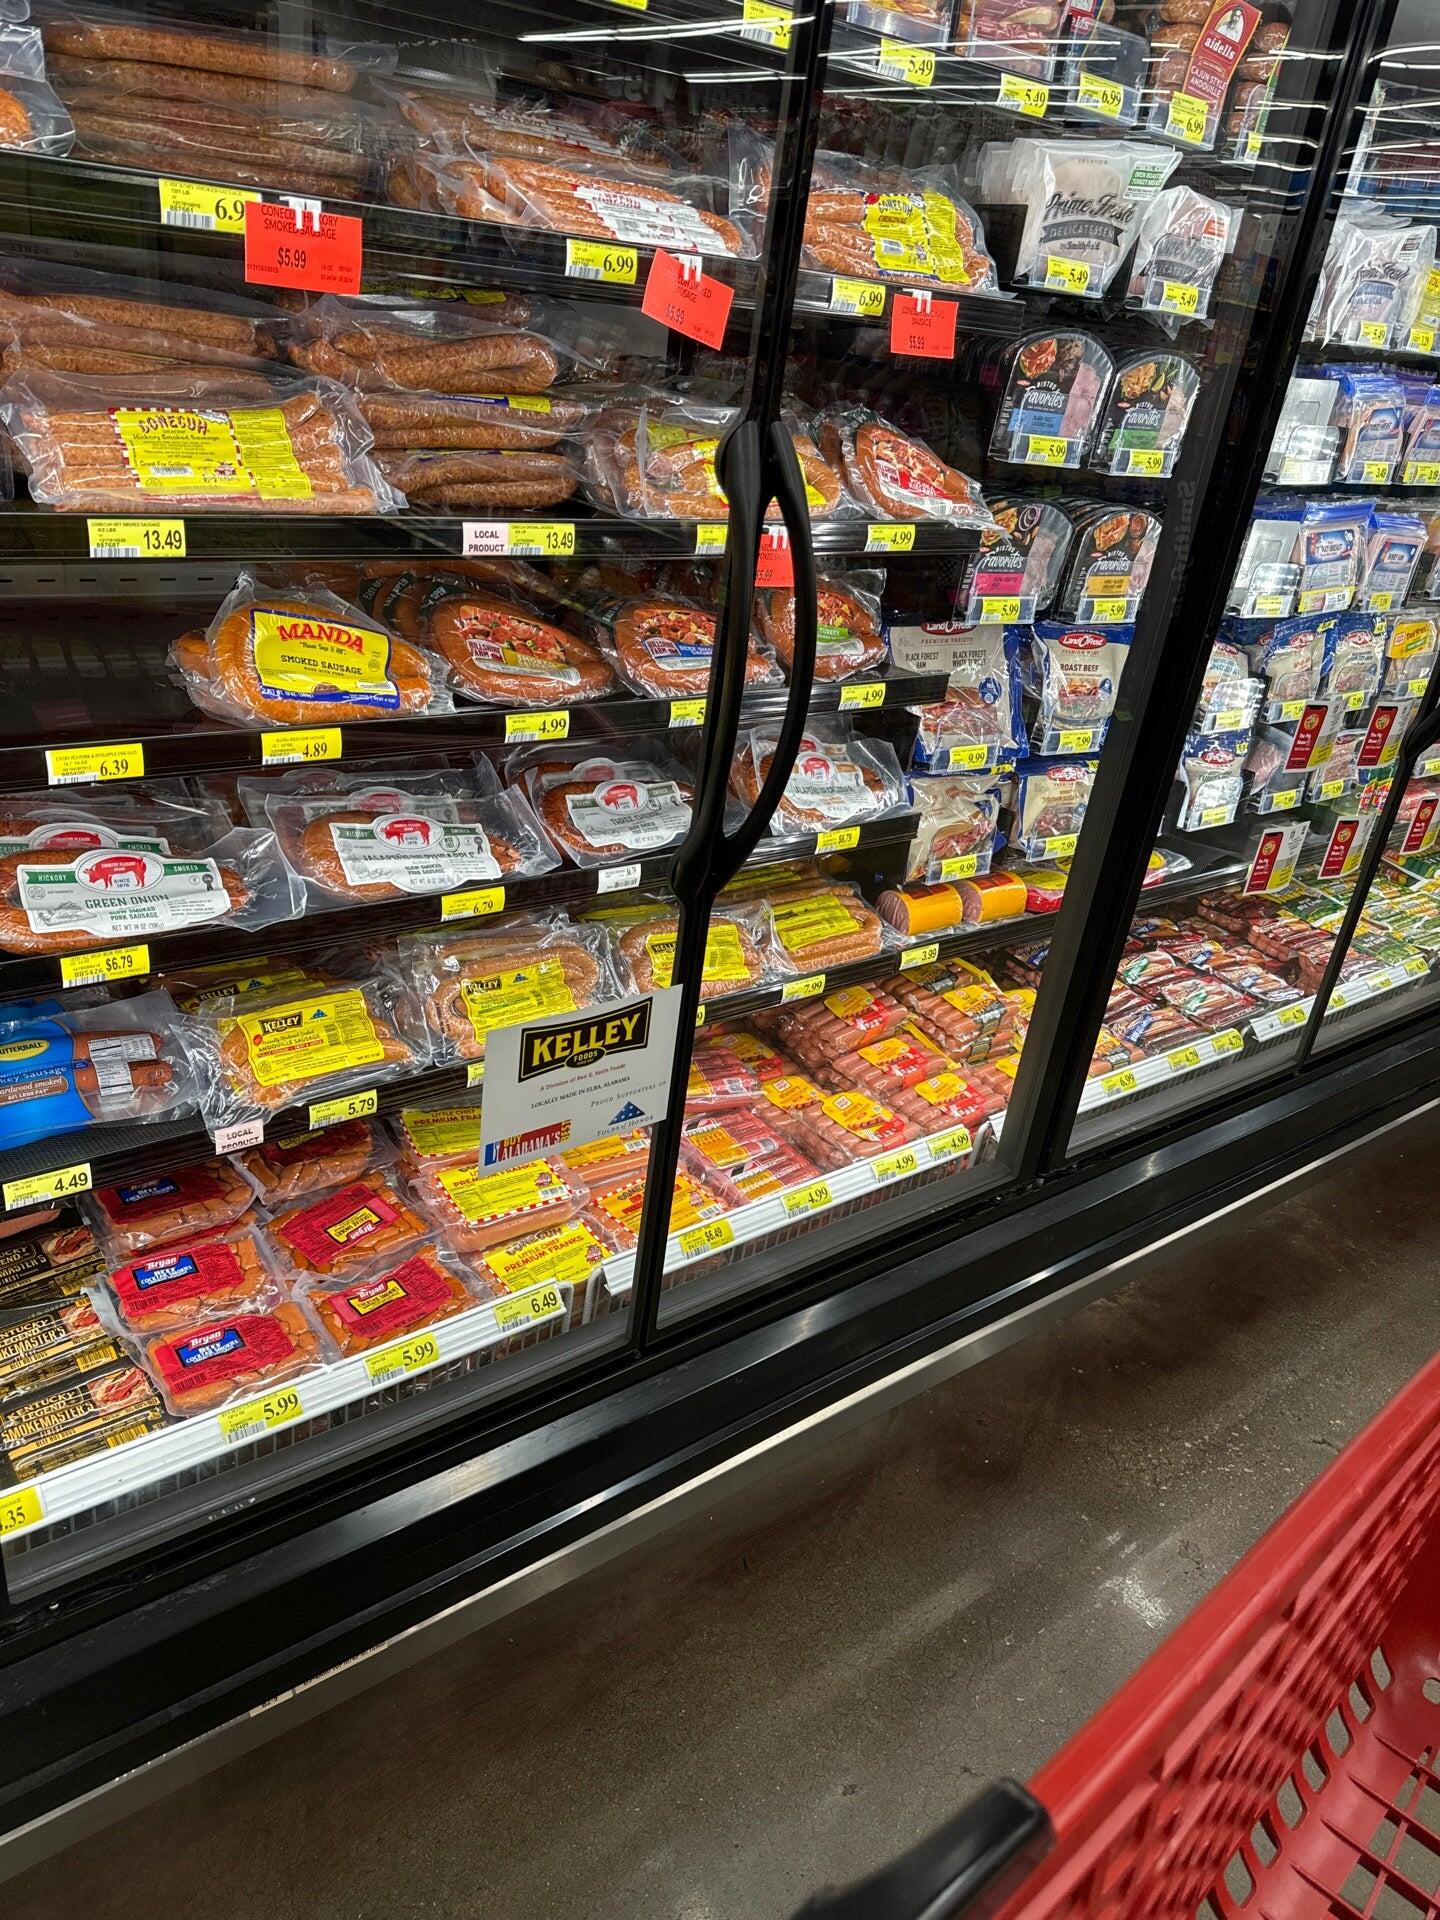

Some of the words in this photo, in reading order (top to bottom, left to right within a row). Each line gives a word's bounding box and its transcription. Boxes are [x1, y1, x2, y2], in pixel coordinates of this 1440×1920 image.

[1204, 36, 1236, 61] aidells
[1101, 89, 1121, 107] 6.99
[261, 204, 297, 220] CONECU
[264, 218, 300, 235] SMOKED
[1050, 222, 1115, 239] DELICATESSEN
[277, 246, 307, 269] $5.99
[603, 253, 634, 275] 6.99
[858, 289, 883, 308] 6.99
[139, 415, 208, 436] CONECUH
[1047, 443, 1066, 458] 5.99
[143, 529, 182, 551] 13.49
[474, 530, 500, 540] LOCAL
[545, 531, 574, 550] 13.49
[889, 531, 912, 546] 4.99
[468, 544, 505, 553] PRODUCT
[276, 623, 366, 655] MANDA
[280, 654, 319, 668] SMOKED
[321, 660, 362, 676] SAUSAGE
[1060, 663, 1083, 673] ROAST
[1083, 663, 1099, 672] BEEF
[863, 689, 883, 703] 4.99
[538, 717, 567, 735] 4.99
[302, 742, 328, 758] 4.89
[967, 751, 985, 765] 9.99
[100, 759, 129, 778] 6.39
[38, 874, 67, 882] HICKORY
[173, 864, 198, 873] SMOKED
[85, 898, 129, 910] GREEN
[473, 901, 494, 915] 6.79
[921, 948, 937, 960] 3.99
[106, 955, 133, 972] $6.79
[803, 981, 822, 994] 7.99
[263, 1016, 300, 1033] KELLEY
[0, 1042, 44, 1055] UTTERBALL
[531, 1013, 641, 1068] KELLEY
[573, 1050, 598, 1063] FOODS
[1119, 1070, 1135, 1088] 6.99
[531, 1096, 559, 1109] LOCALLY
[560, 1090, 578, 1101] MADE
[603, 1076, 631, 1088] ALABAMA
[347, 1097, 375, 1115] 5.79
[412, 1116, 459, 1126] PREMIUM
[503, 1134, 522, 1148] BUY
[950, 1133, 969, 1149] 4.99
[895, 1154, 914, 1171] 4.99
[54, 1171, 88, 1192] 4.49
[808, 1187, 829, 1205] 4.99
[146, 1256, 177, 1270] Bryan
[503, 1253, 547, 1274] PREMIUM
[548, 1235, 585, 1253] FRANKS
[357, 1282, 385, 1299] Bryan
[530, 1290, 558, 1315] 6.49
[190, 1329, 222, 1347] Bryan
[401, 1341, 434, 1366] 5.99
[262, 1393, 299, 1421] 5.99
[1, 1401, 95, 1443] SMOKEMASTER'S
